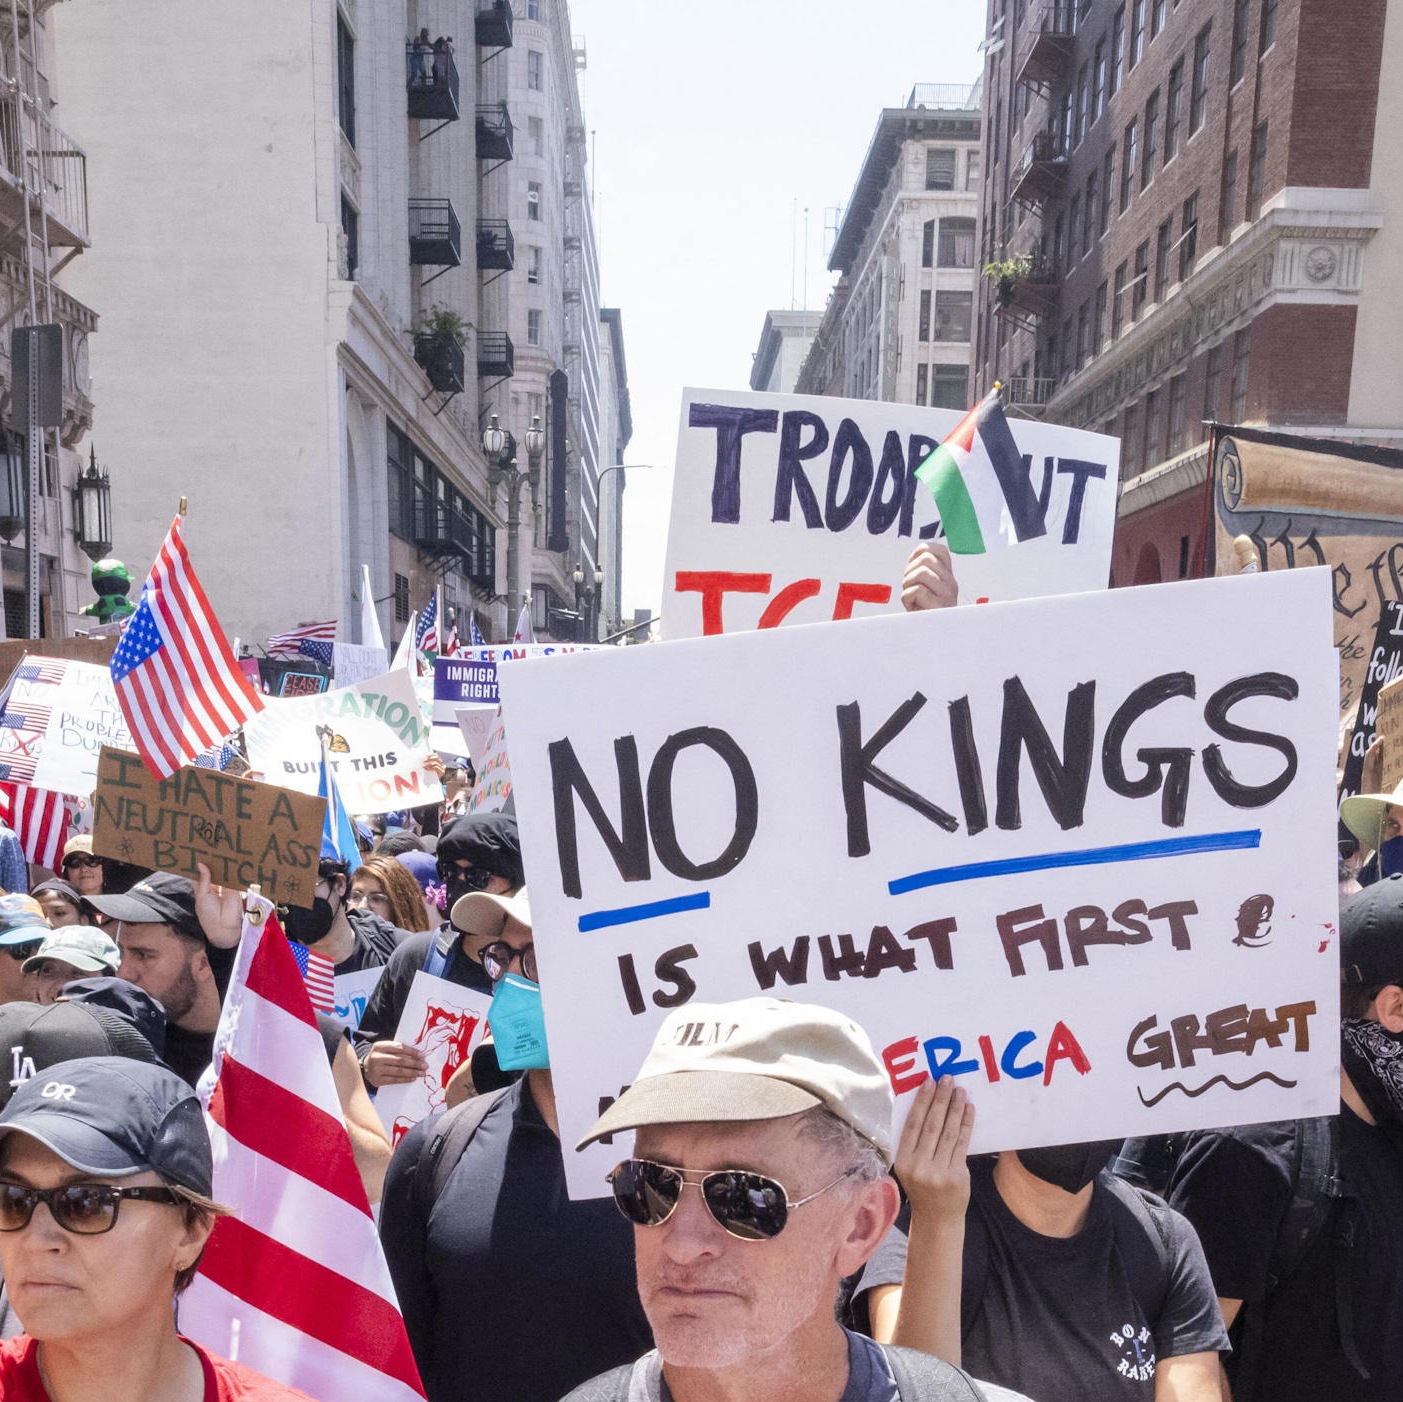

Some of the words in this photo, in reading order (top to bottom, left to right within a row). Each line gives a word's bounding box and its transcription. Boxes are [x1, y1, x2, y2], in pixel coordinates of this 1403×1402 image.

[688, 403, 949, 540] TROOP
[284, 674, 320, 691] CEASE
[461, 683, 500, 700] RIGHT
[281, 760, 341, 775] BUIT
[350, 750, 399, 773] THIS
[547, 725, 760, 900] NO
[835, 670, 1301, 859] KINGS
[159, 770, 257, 820] HATE
[269, 796, 300, 833] A
[97, 796, 254, 857] NEUTRAL
[259, 832, 314, 871] ASS
[153, 839, 278, 895] BITCH
[617, 942, 699, 1017] IS
[747, 914, 958, 992] WHAT
[995, 898, 1200, 979] FIRST
[883, 1019, 1094, 1097] ERICA
[1126, 1000, 1318, 1072] GREAT
[40, 1081, 76, 1101] OR
